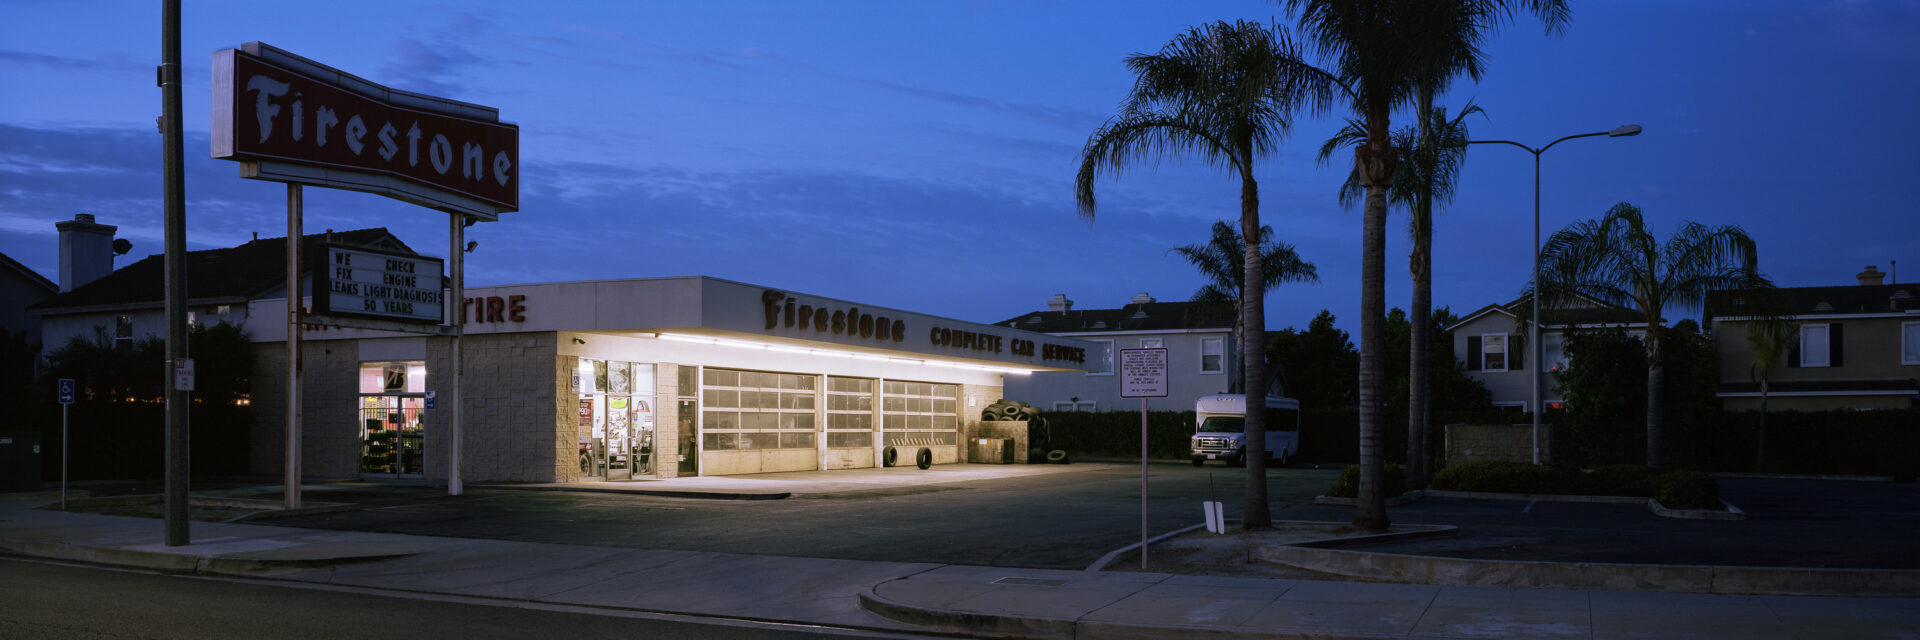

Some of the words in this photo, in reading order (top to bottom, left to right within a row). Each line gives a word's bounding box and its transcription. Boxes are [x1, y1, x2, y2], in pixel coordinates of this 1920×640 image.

[246, 74, 511, 187] Firestone
[336, 253, 351, 265] WE
[386, 259, 415, 274] CHECK
[337, 267, 352, 280] FIX
[384, 273, 416, 287] ENGINE
[329, 281, 358, 295] LEAKS
[364, 286, 393, 299] LIGHT
[393, 288, 443, 304] DIAGNOSIS
[364, 299, 376, 312] 50
[384, 302, 414, 314] YEARS
[762, 289, 905, 342] Firestone
[931, 326, 1002, 353] COMPLETE
[1011, 338, 1034, 356] CAR
[1042, 343, 1085, 362] SERVICE
